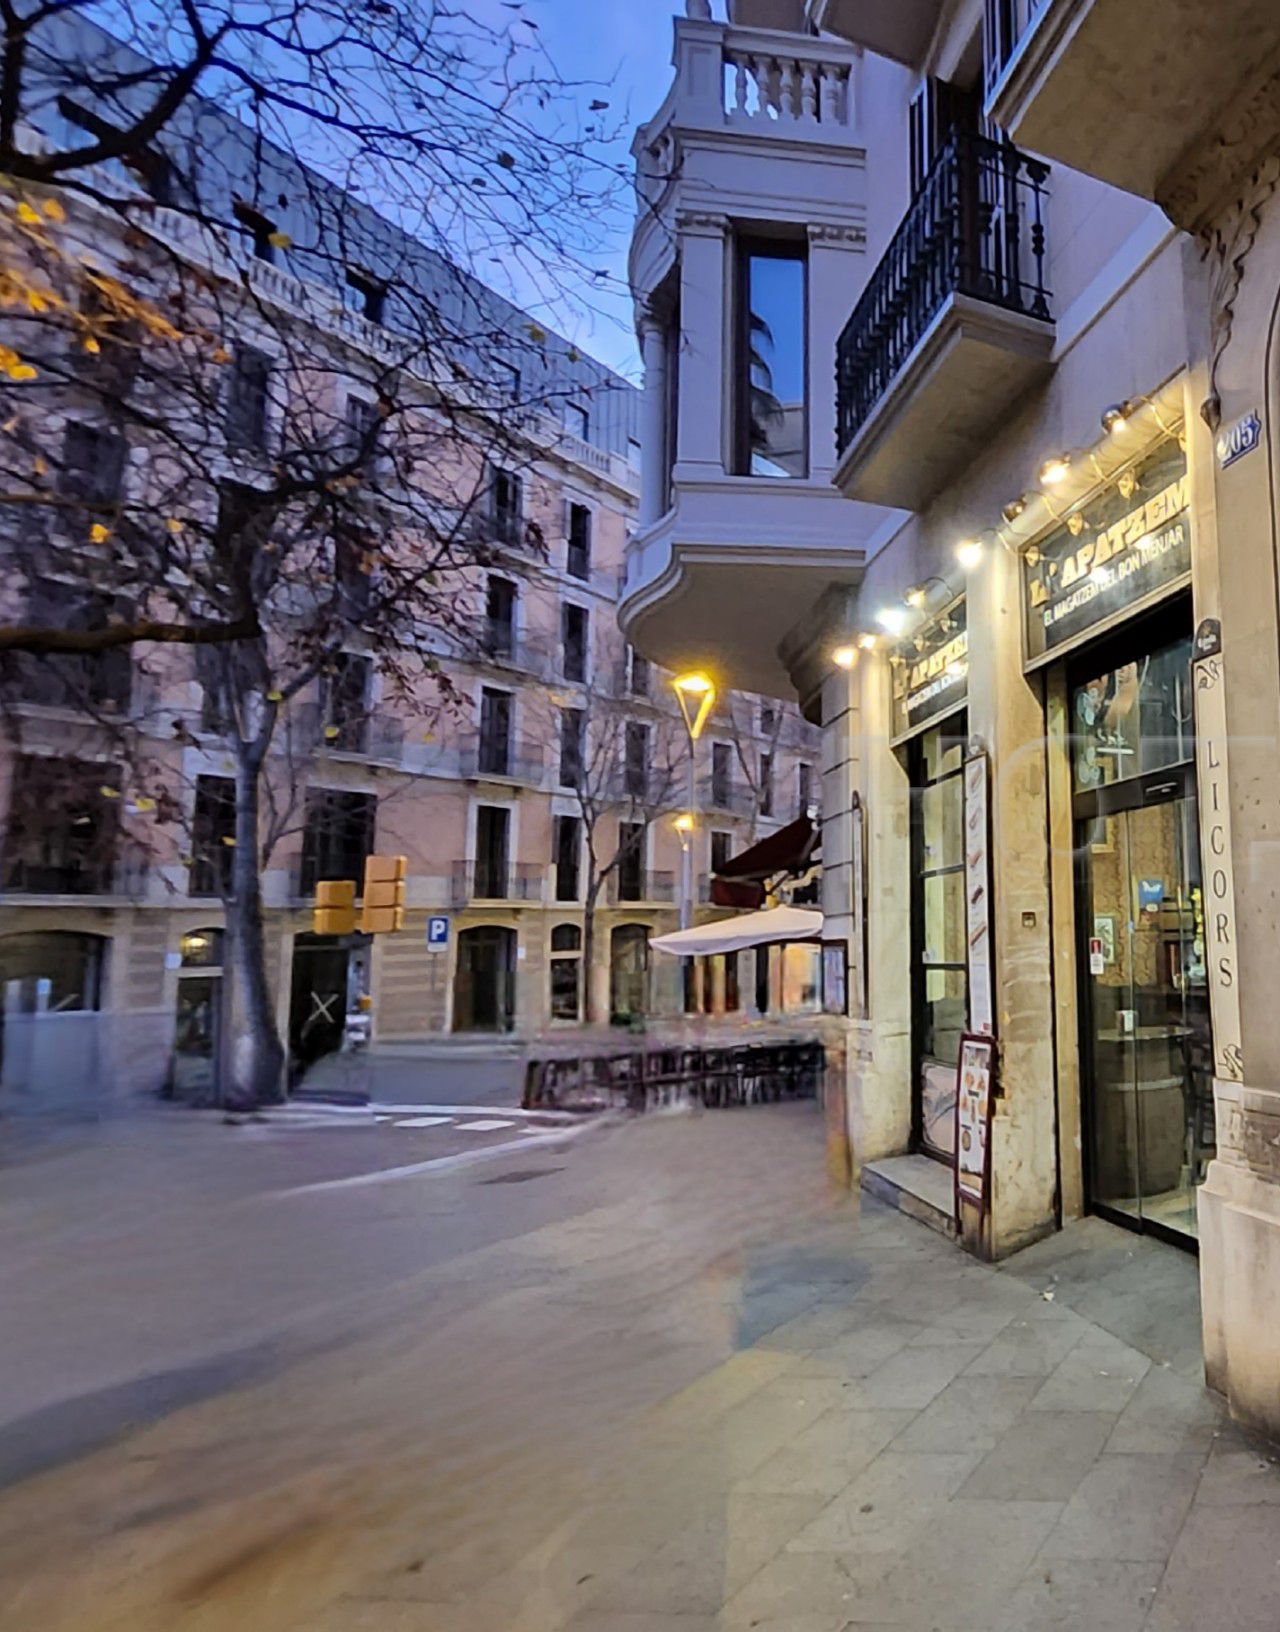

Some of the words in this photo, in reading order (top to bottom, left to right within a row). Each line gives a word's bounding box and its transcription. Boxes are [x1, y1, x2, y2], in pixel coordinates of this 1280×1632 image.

[1217, 417, 1253, 462] 205
[1118, 552, 1140, 580] BON
[1206, 740, 1234, 988] LICORS
[431, 919, 446, 941] P
